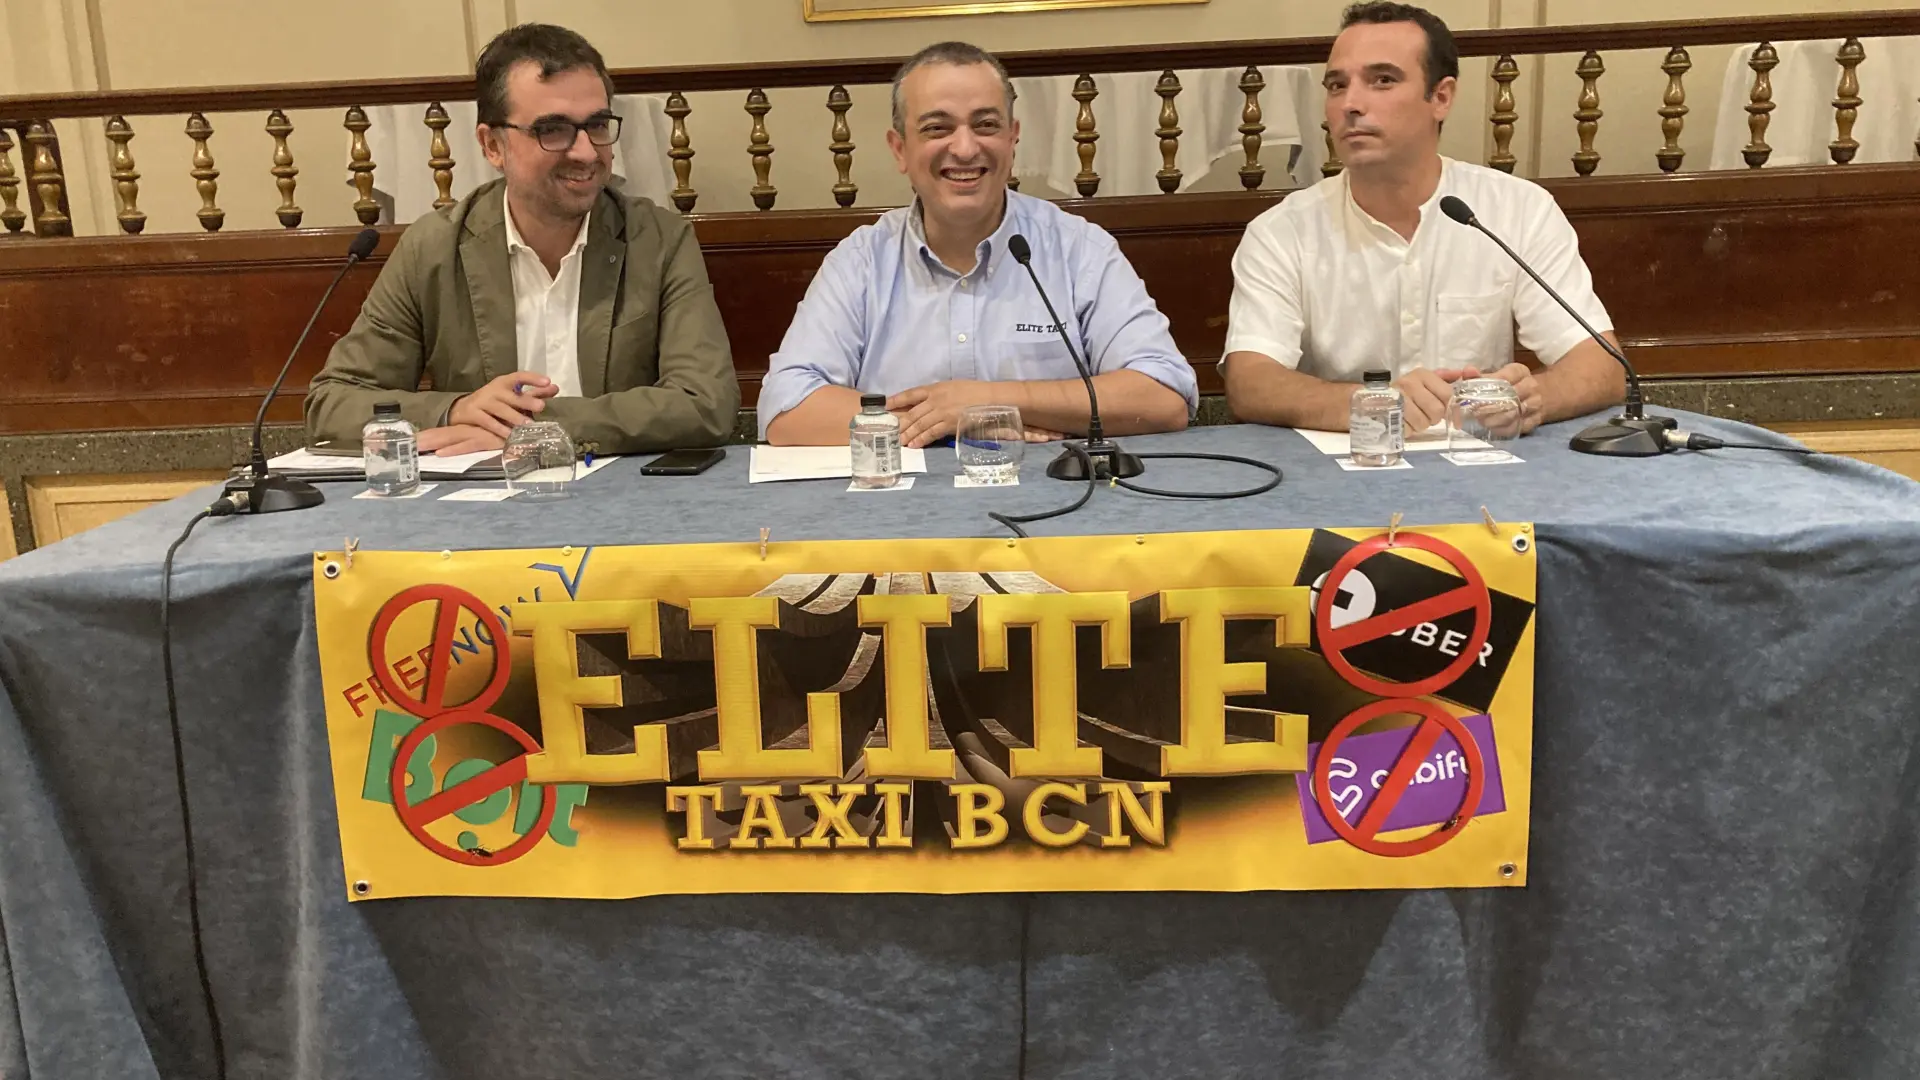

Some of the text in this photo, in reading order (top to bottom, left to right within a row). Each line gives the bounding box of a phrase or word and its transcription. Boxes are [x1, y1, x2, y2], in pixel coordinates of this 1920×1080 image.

[1016, 321, 1067, 333] ELITE TAI
[1385, 619, 1494, 667] BER
[512, 584, 1310, 784] ELITE
[1370, 750, 1469, 789] cbif
[665, 780, 1171, 849] TAXI BCN
